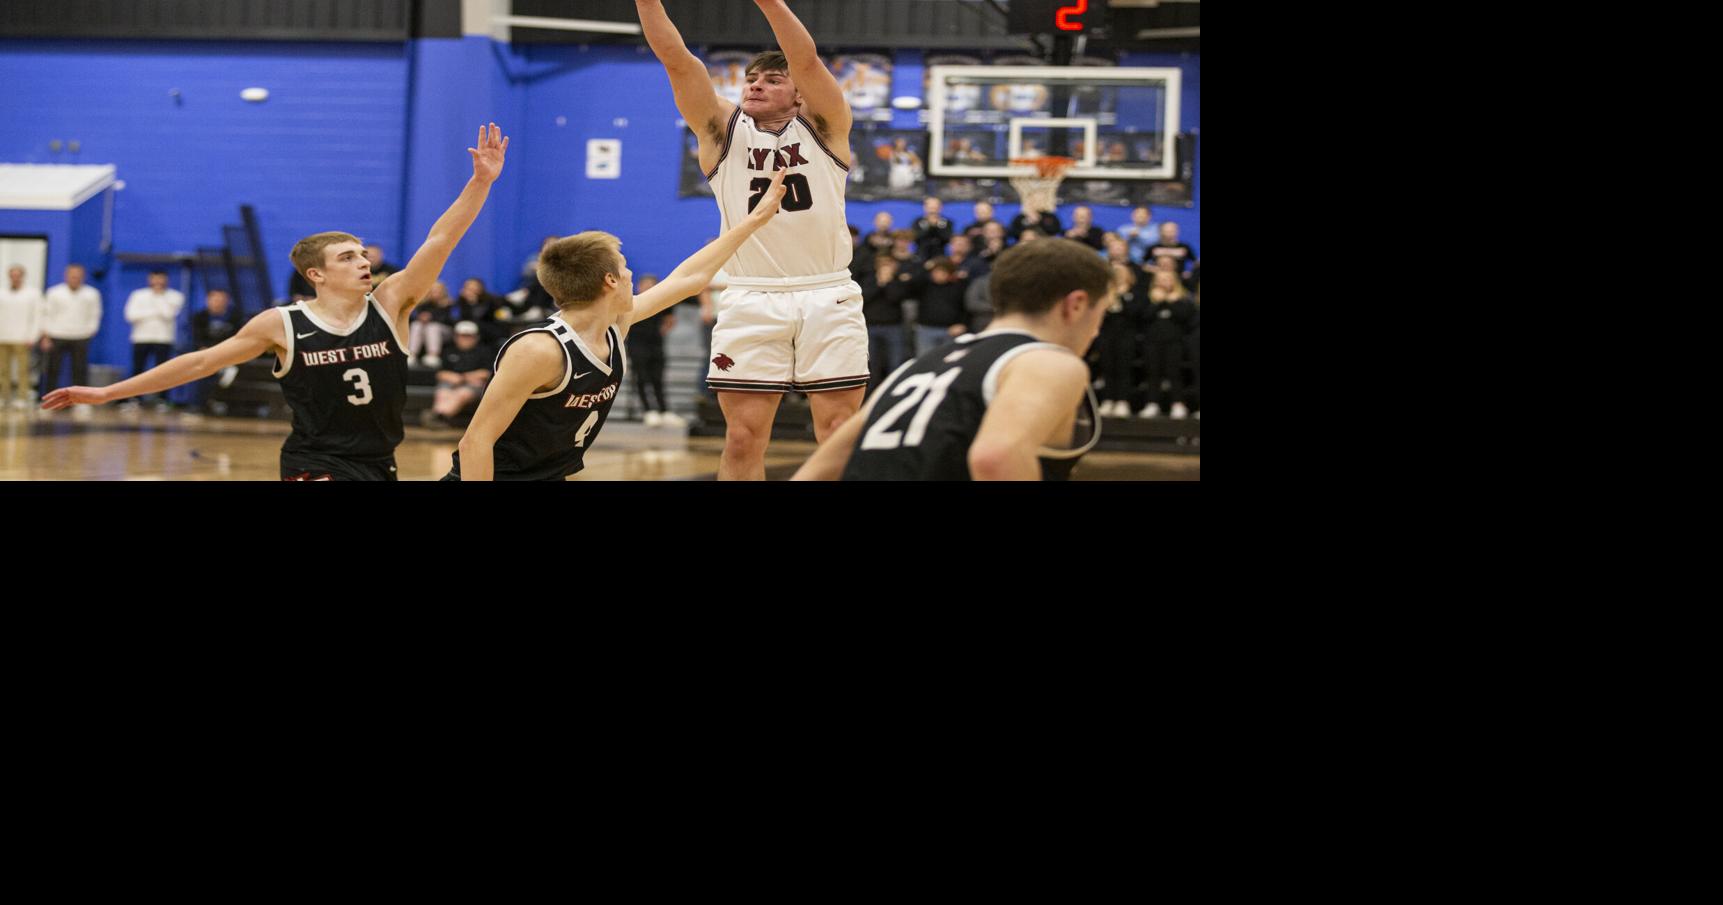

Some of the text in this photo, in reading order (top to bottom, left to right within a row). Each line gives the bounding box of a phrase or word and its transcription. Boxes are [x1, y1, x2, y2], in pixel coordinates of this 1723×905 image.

[1055, 0, 1088, 31] 2
[748, 173, 813, 215] 20
[302, 341, 391, 366] WEST FORK
[342, 368, 373, 406] 3
[860, 366, 962, 450] 21
[574, 410, 599, 447] 4
